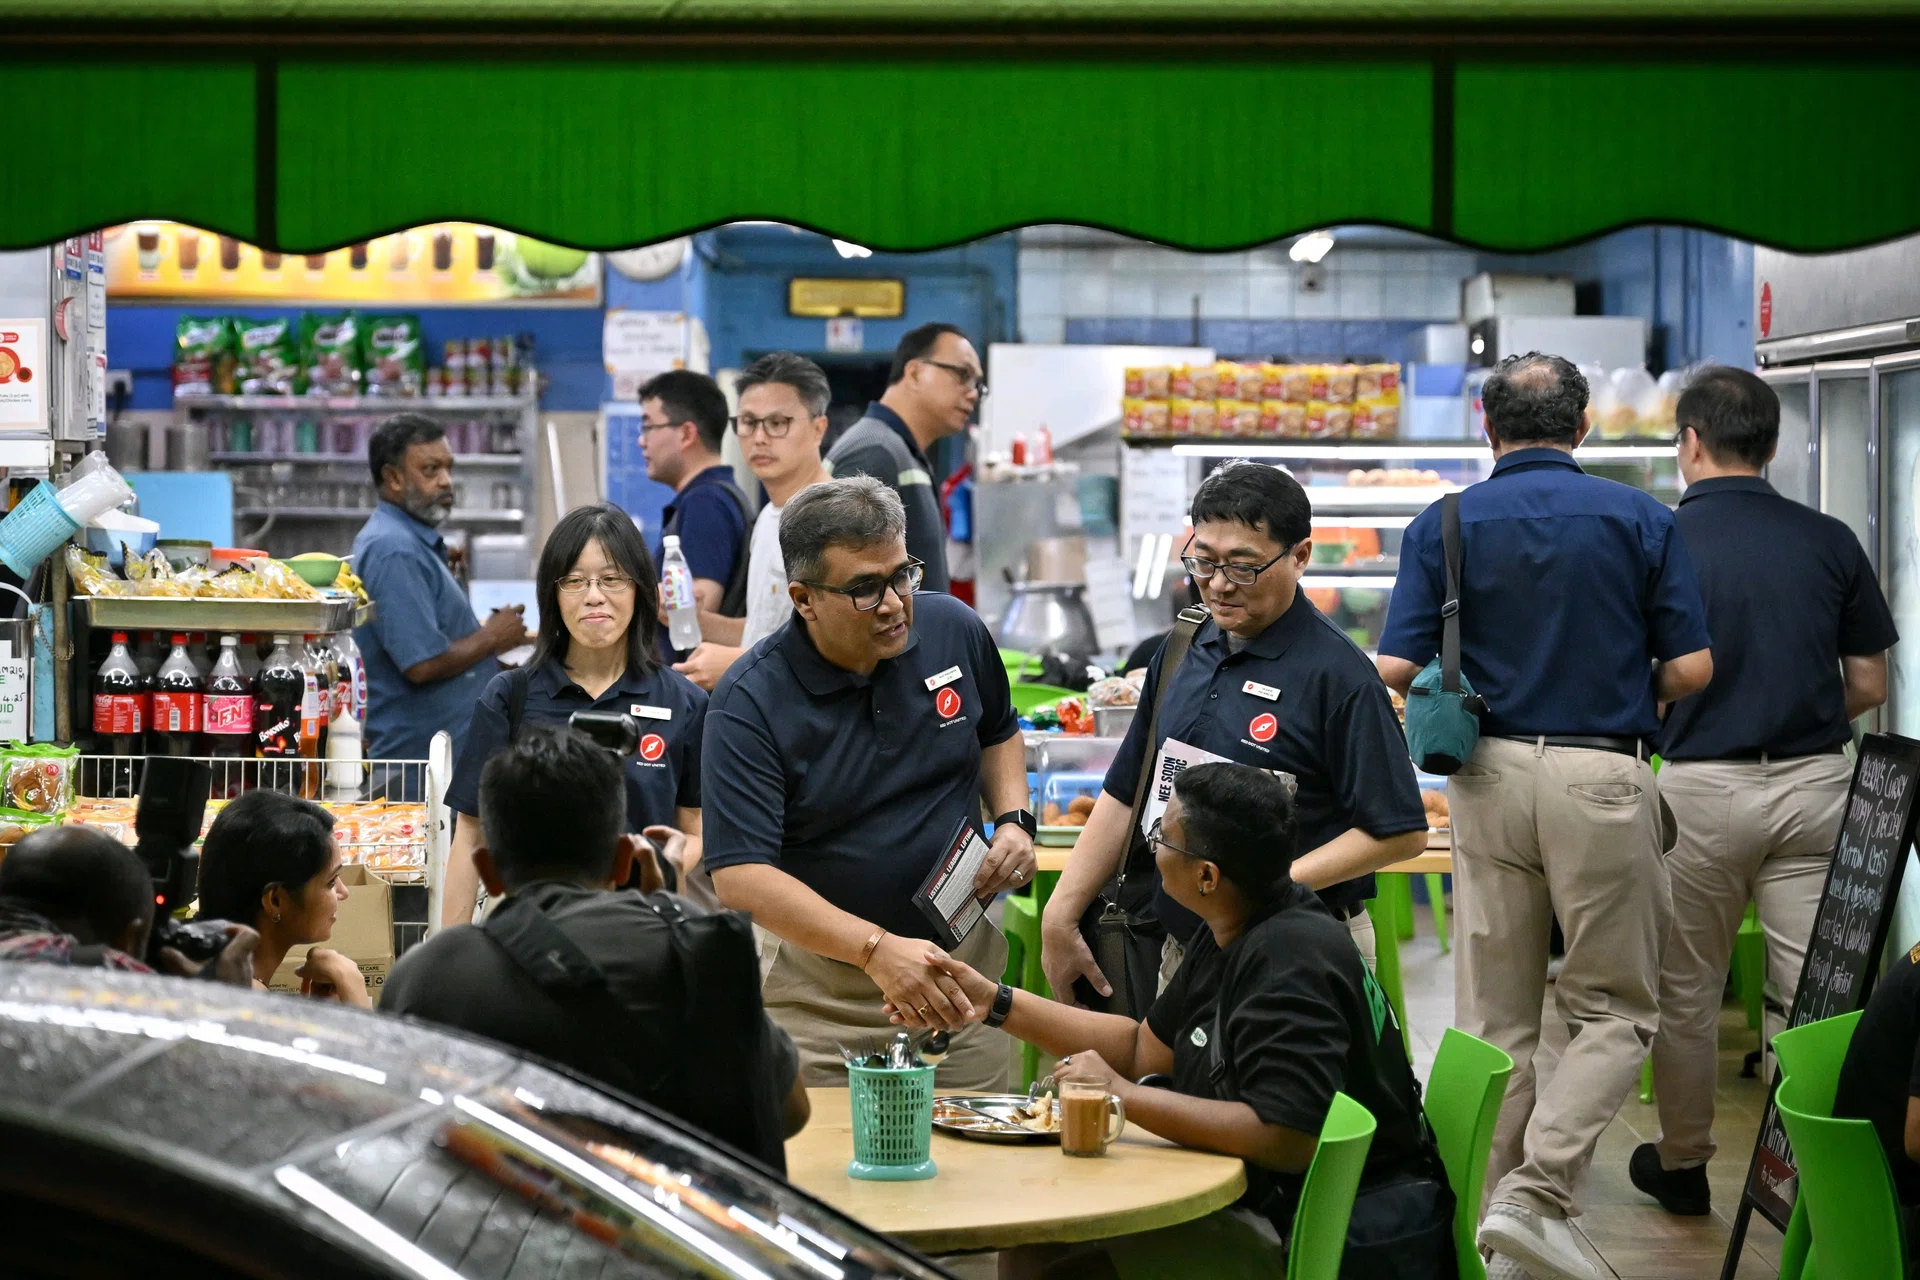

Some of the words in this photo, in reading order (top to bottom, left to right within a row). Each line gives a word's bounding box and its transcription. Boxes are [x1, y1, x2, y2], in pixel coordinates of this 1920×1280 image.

[1161, 756, 1176, 783] SOON
[1174, 759, 1188, 776] RC
[1157, 783, 1172, 802] NEE
[960, 827, 975, 850] LIFTING
